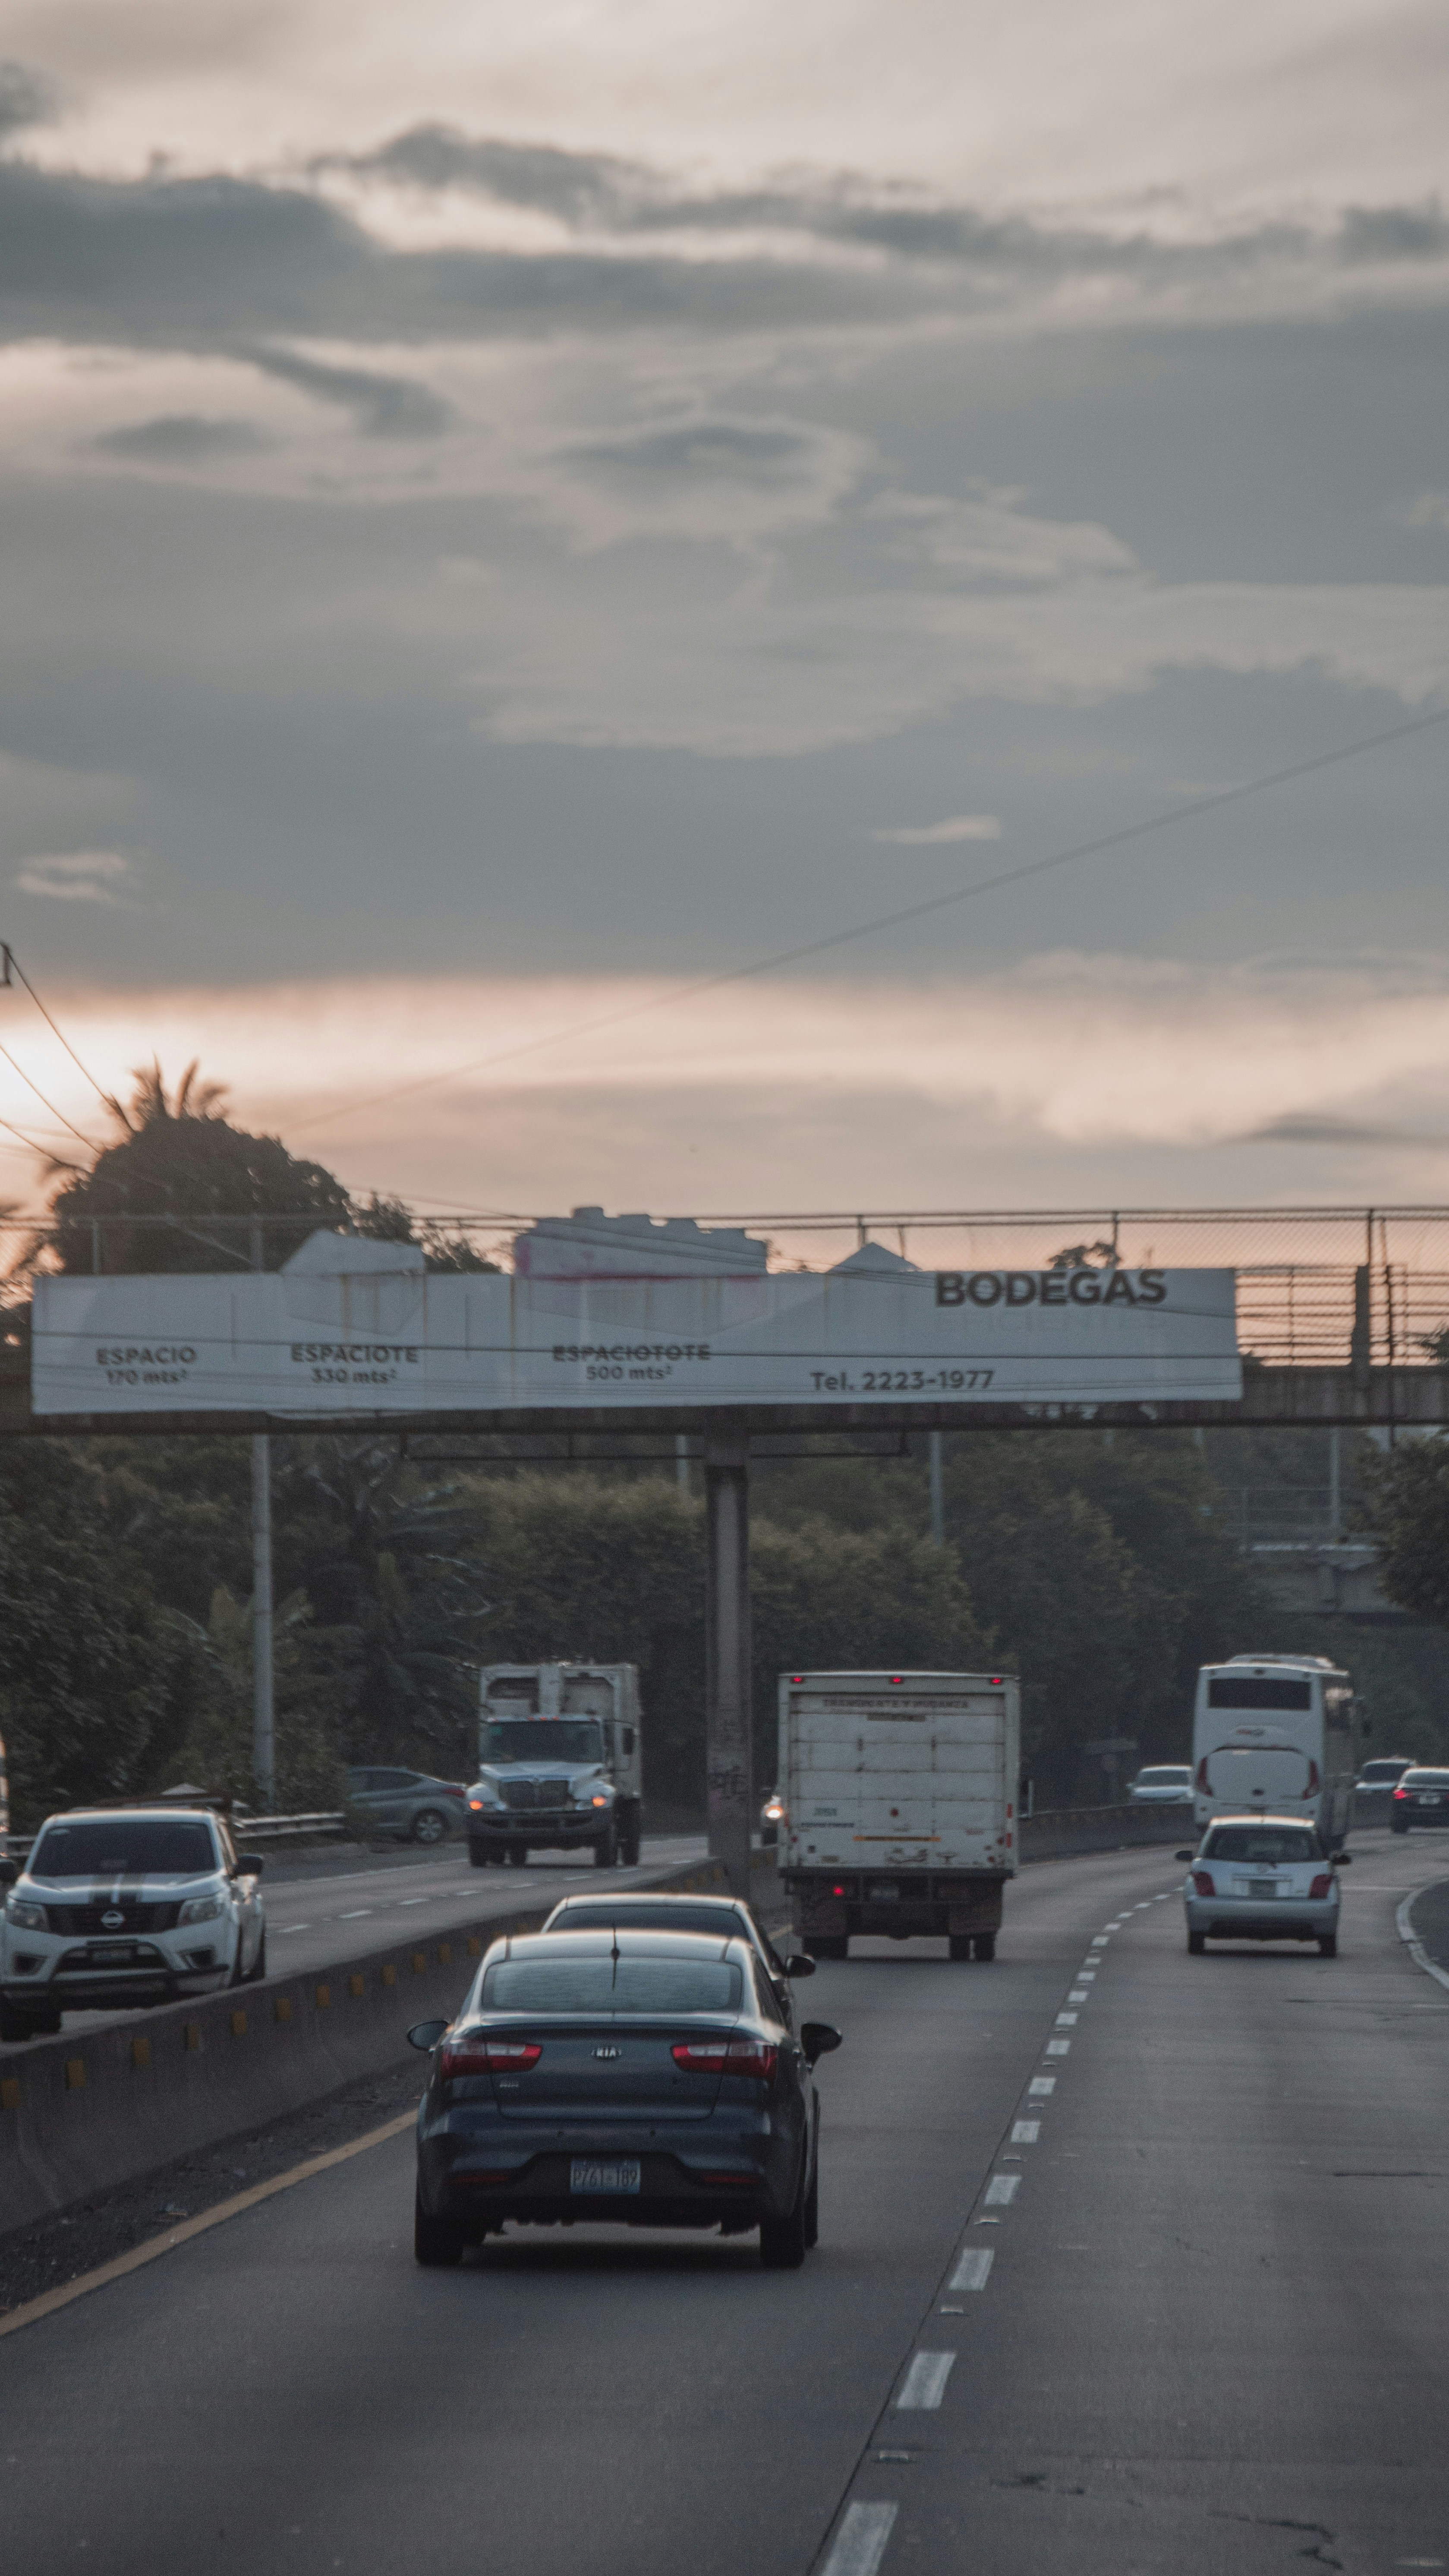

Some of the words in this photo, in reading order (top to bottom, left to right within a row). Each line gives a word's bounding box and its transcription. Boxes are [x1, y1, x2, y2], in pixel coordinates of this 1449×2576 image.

[935, 1271, 1166, 1307] BODEGAS
[96, 1347, 197, 1365] ESPACIO
[291, 1343, 418, 1363] ESPACIOTE
[553, 1345, 711, 1362] ESPACIOTOTE
[586, 1366, 623, 1381] 500
[810, 1372, 856, 1391] Tel.
[862, 1370, 995, 1390] 2223-1977
[595, 2046, 617, 2058] KIA
